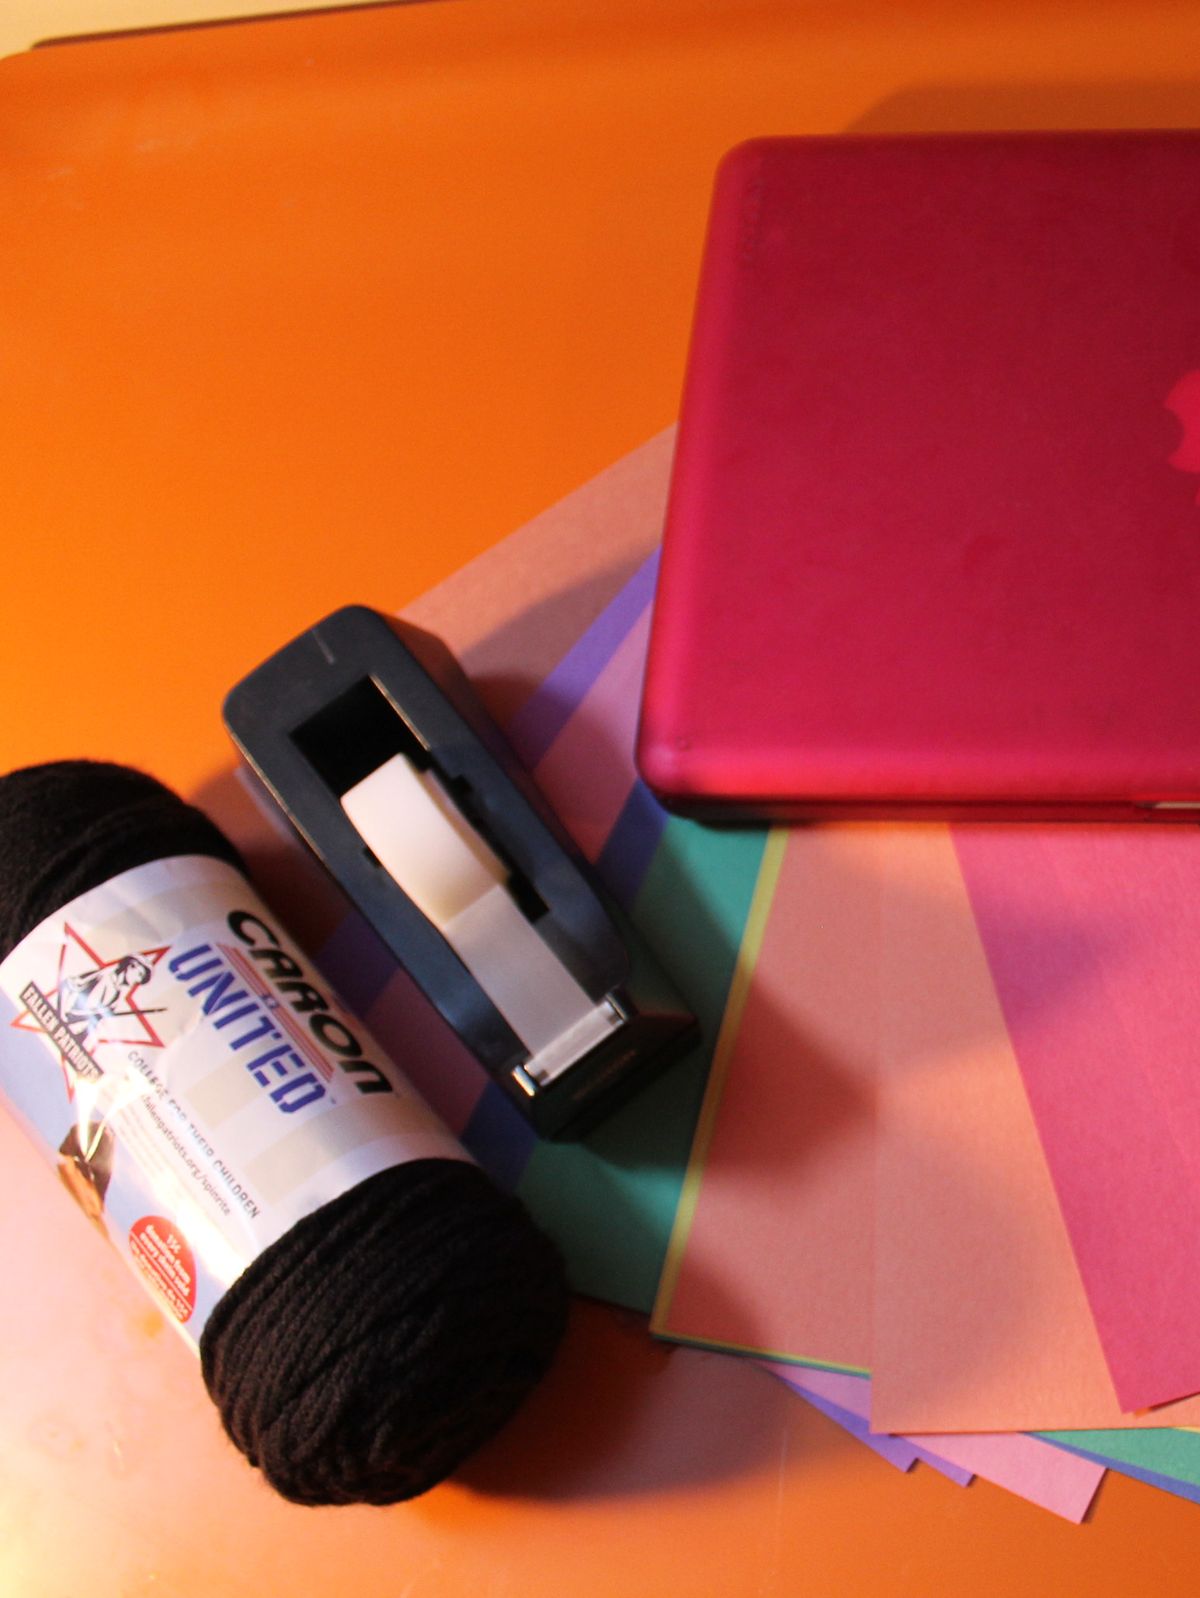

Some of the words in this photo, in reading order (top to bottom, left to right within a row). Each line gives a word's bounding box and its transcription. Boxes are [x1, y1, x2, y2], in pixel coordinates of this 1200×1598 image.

[23, 987, 59, 1032] FALLEN
[168, 944, 327, 1113] UNITED
[227, 910, 393, 1094] CARON
[212, 1159, 261, 1219] CHILDREN
